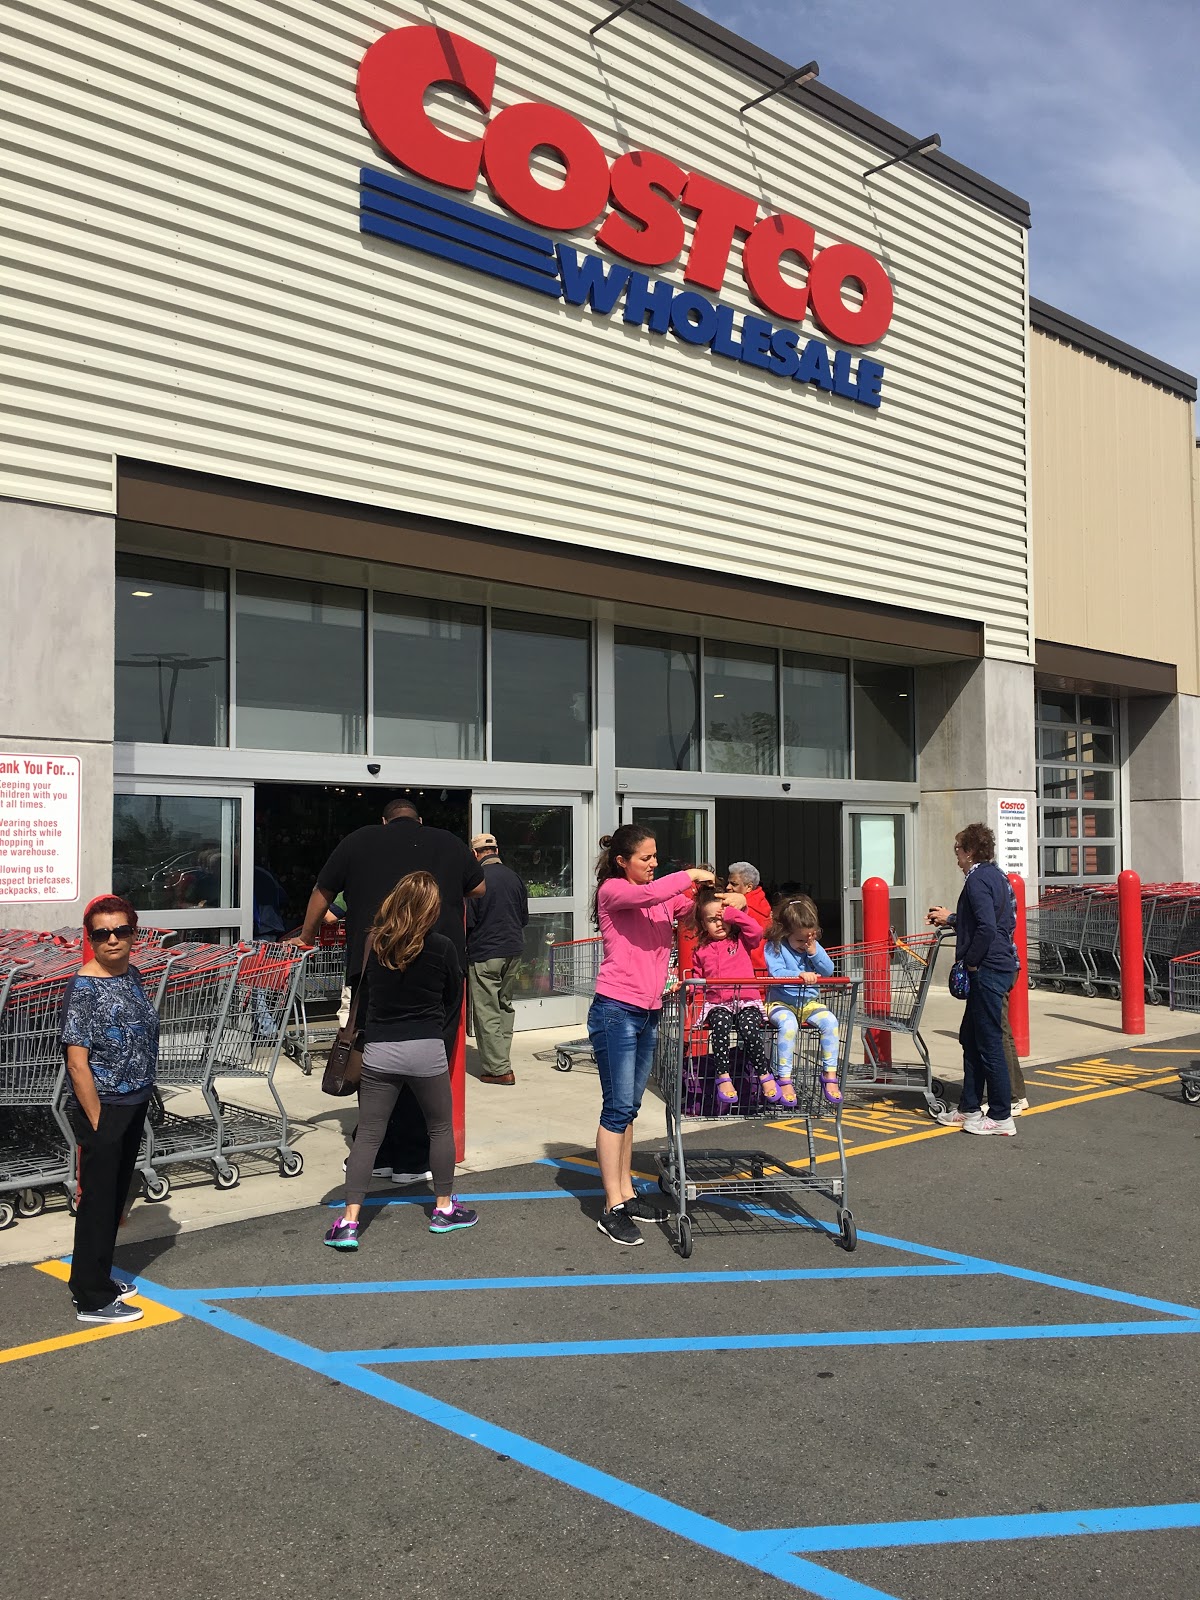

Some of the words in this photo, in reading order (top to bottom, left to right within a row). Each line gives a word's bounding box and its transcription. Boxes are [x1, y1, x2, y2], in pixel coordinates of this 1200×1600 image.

[356, 25, 894, 346] COSTCO
[554, 243, 885, 409] WHOLESALE
[23, 760, 43, 775] You
[46, 761, 75, 776] For...
[0, 780, 31, 791] eeping
[32, 782, 52, 791] your
[32, 790, 51, 799] with
[52, 792, 68, 801] you
[6, 799, 17, 809] all
[20, 799, 46, 809] times.
[1000, 801, 1025, 810] COSTCO
[33, 818, 58, 827] shoes
[13, 828, 37, 837] shirts
[39, 828, 62, 837] while
[36, 838, 44, 847] in
[10, 848, 59, 857] warehouse.
[33, 866, 44, 874] us
[46, 865, 54, 873] to
[43, 886, 59, 894] etc.
